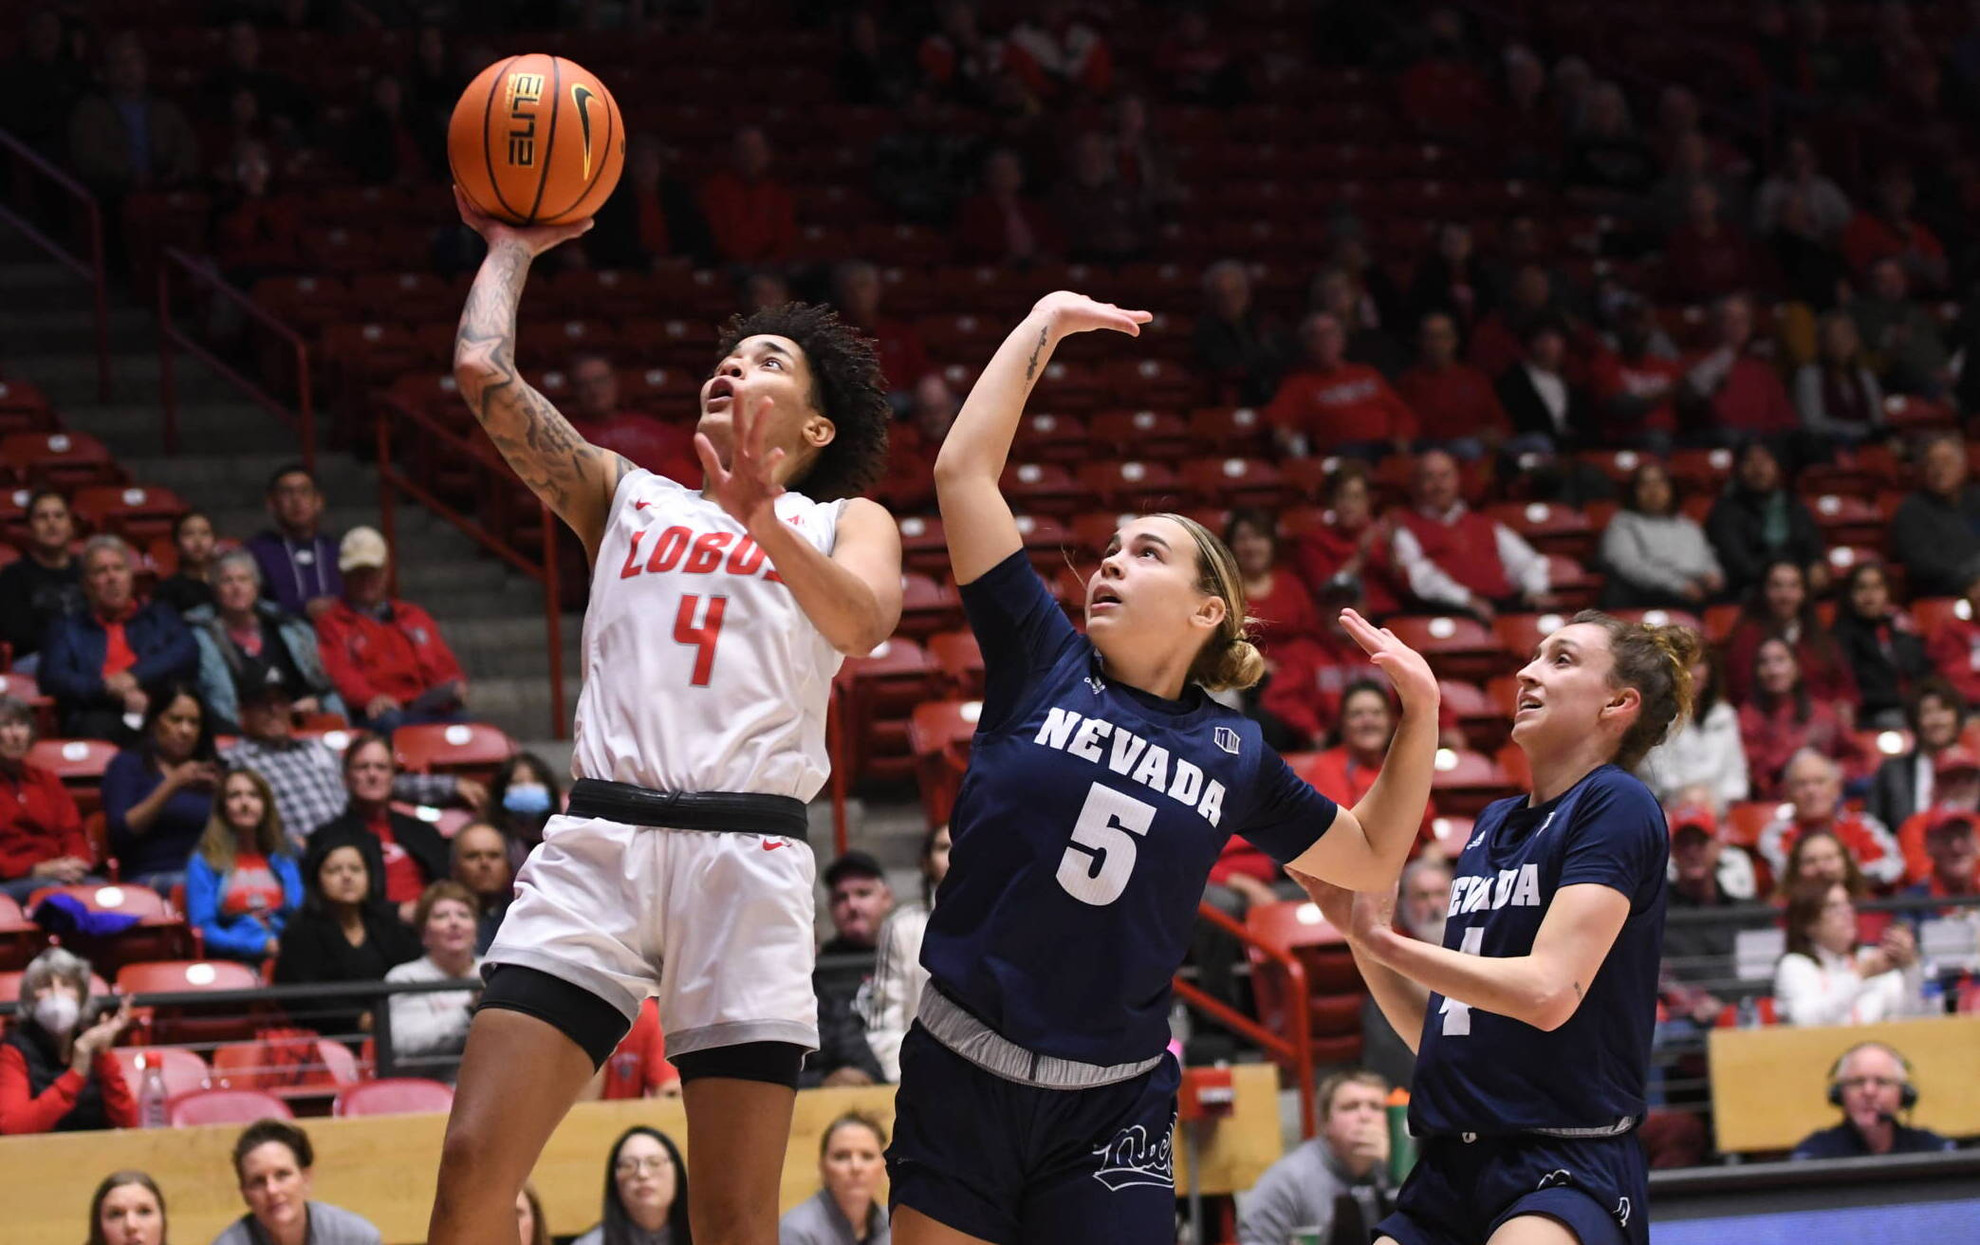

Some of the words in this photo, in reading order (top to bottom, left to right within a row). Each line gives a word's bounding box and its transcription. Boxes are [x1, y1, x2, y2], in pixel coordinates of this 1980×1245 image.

[509, 75, 543, 166] ELITE
[672, 594, 729, 688] 4
[1034, 707, 1226, 828] NEVADA
[1056, 781, 1158, 907] 5
[1446, 863, 1541, 918] EVADA
